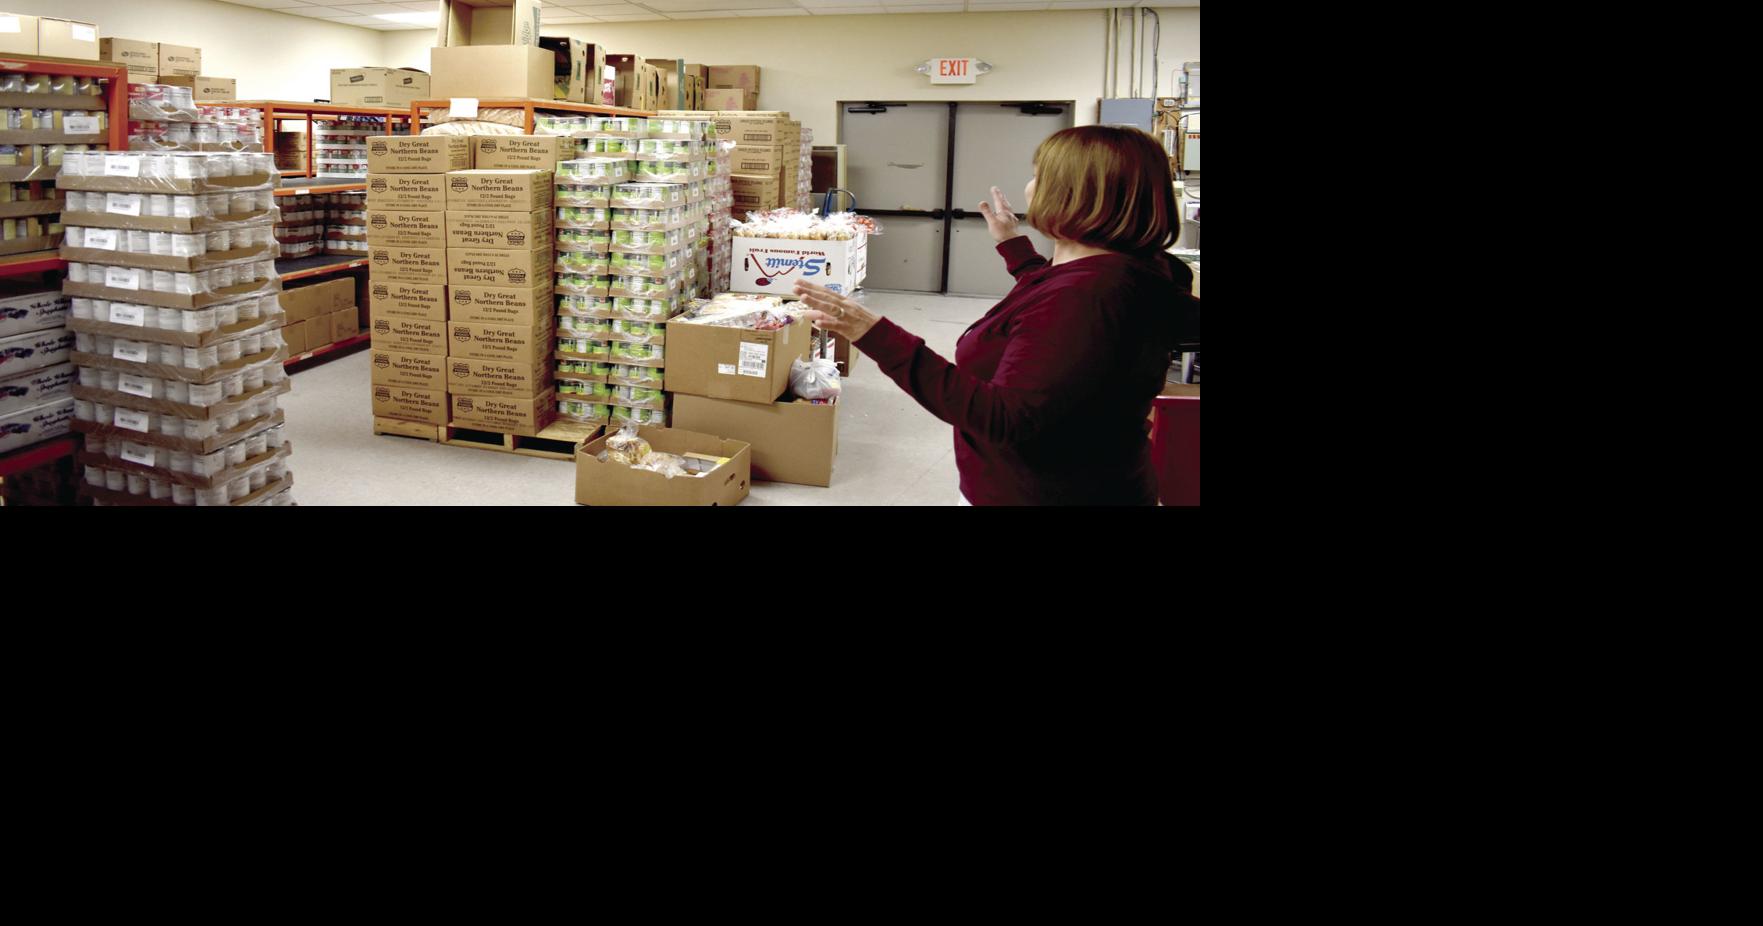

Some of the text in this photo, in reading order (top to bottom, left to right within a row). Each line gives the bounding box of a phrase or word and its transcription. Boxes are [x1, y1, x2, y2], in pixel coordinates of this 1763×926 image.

[940, 60, 968, 76] EXIT
[766, 257, 826, 276] Stemilt
[391, 293, 417, 301] Northern
[474, 298, 504, 306] Northern
[401, 322, 412, 330] Dry
[392, 328, 420, 336] Northern
[483, 329, 495, 337] Dry
[474, 335, 525, 345] Northern Beans
[392, 362, 419, 370] Northern
[473, 371, 502, 379] Northern
[414, 392, 431, 400] Great
[392, 396, 439, 407] Northern Beans
[485, 401, 517, 410] Dry Great
[476, 406, 527, 418] Northern Beans
